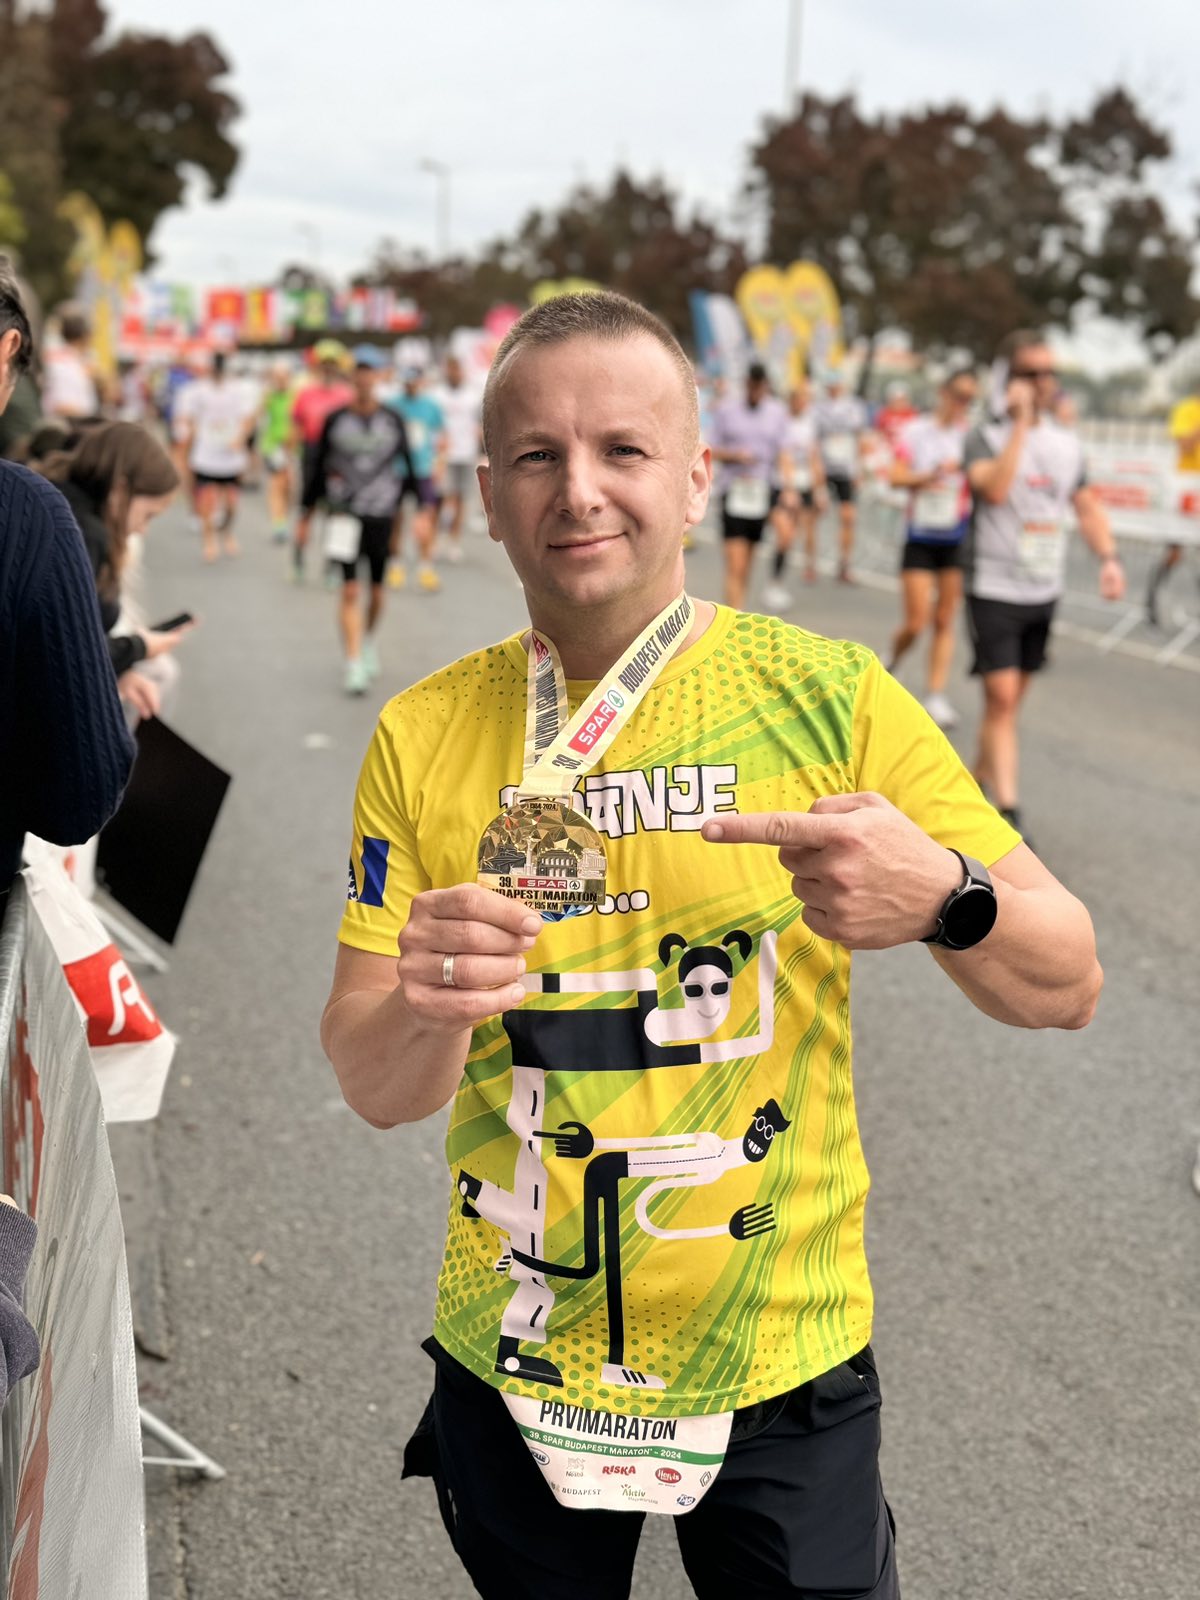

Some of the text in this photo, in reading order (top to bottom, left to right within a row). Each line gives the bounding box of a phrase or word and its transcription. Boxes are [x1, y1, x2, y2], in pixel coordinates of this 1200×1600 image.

[578, 703, 614, 746] SPAR
[618, 635, 661, 694] BUDAPEST
[499, 763, 738, 839] ANJE
[499, 876, 567, 889] 39. SPAR
[491, 888, 539, 900] DAPEST
[543, 891, 598, 902] MARATON
[547, 903, 559, 911] KM
[539, 1401, 677, 1441] PRVIMARATON
[529, 1430, 542, 1440] 39.
[542, 1435, 563, 1447] SPAR
[564, 1441, 608, 1454] BUDAPEST
[660, 1450, 682, 1460] 2024
[602, 1465, 636, 1476] RISKA
[562, 1487, 602, 1496] BUDAPEST
